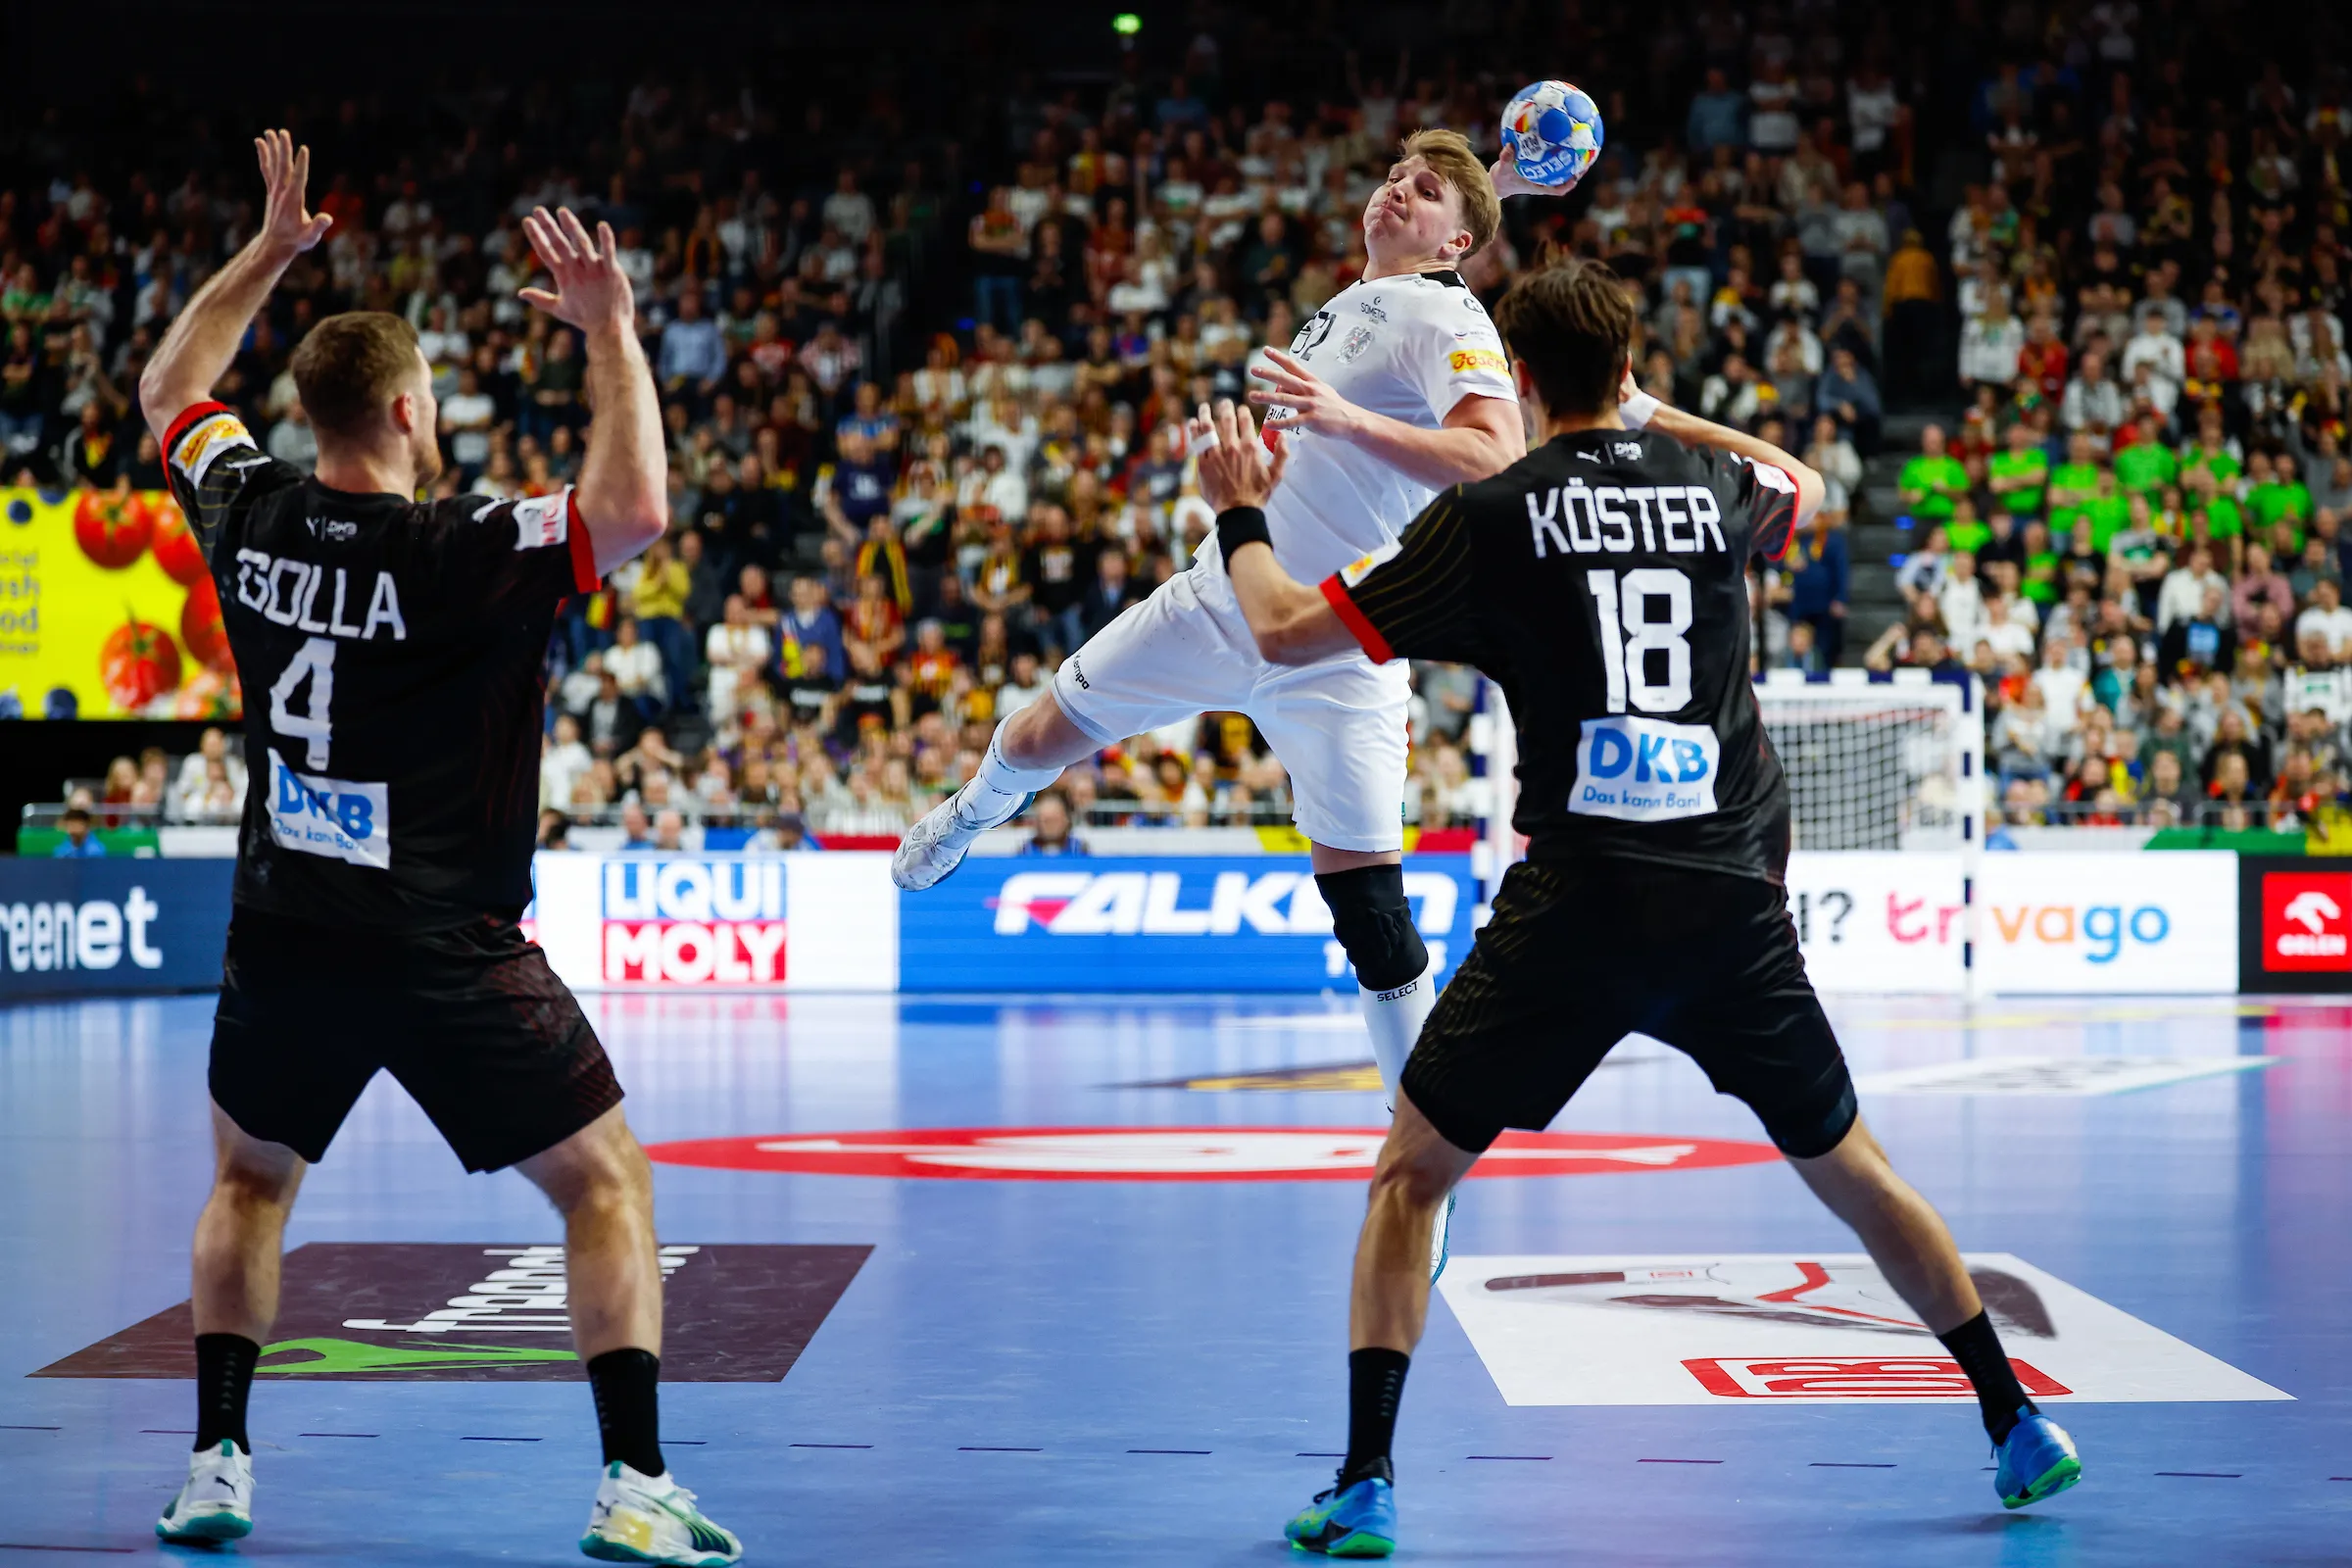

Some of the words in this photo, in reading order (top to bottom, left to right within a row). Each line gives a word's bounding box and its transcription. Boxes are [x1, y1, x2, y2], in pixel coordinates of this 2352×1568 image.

[1525, 476, 1727, 559] KÖSTER
[235, 547, 407, 640] GOLLA
[1072, 651, 1091, 690] Kempa
[1587, 567, 1693, 713] 18
[269, 636, 337, 772] 4
[1590, 727, 1709, 784] DKB
[1582, 785, 1616, 805] Das
[1622, 789, 1661, 808] kann
[606, 860, 781, 921] LIQUI
[606, 922, 785, 983] MOLY
[1886, 891, 2171, 963] trvago
[1377, 981, 1419, 1003] SELECT
